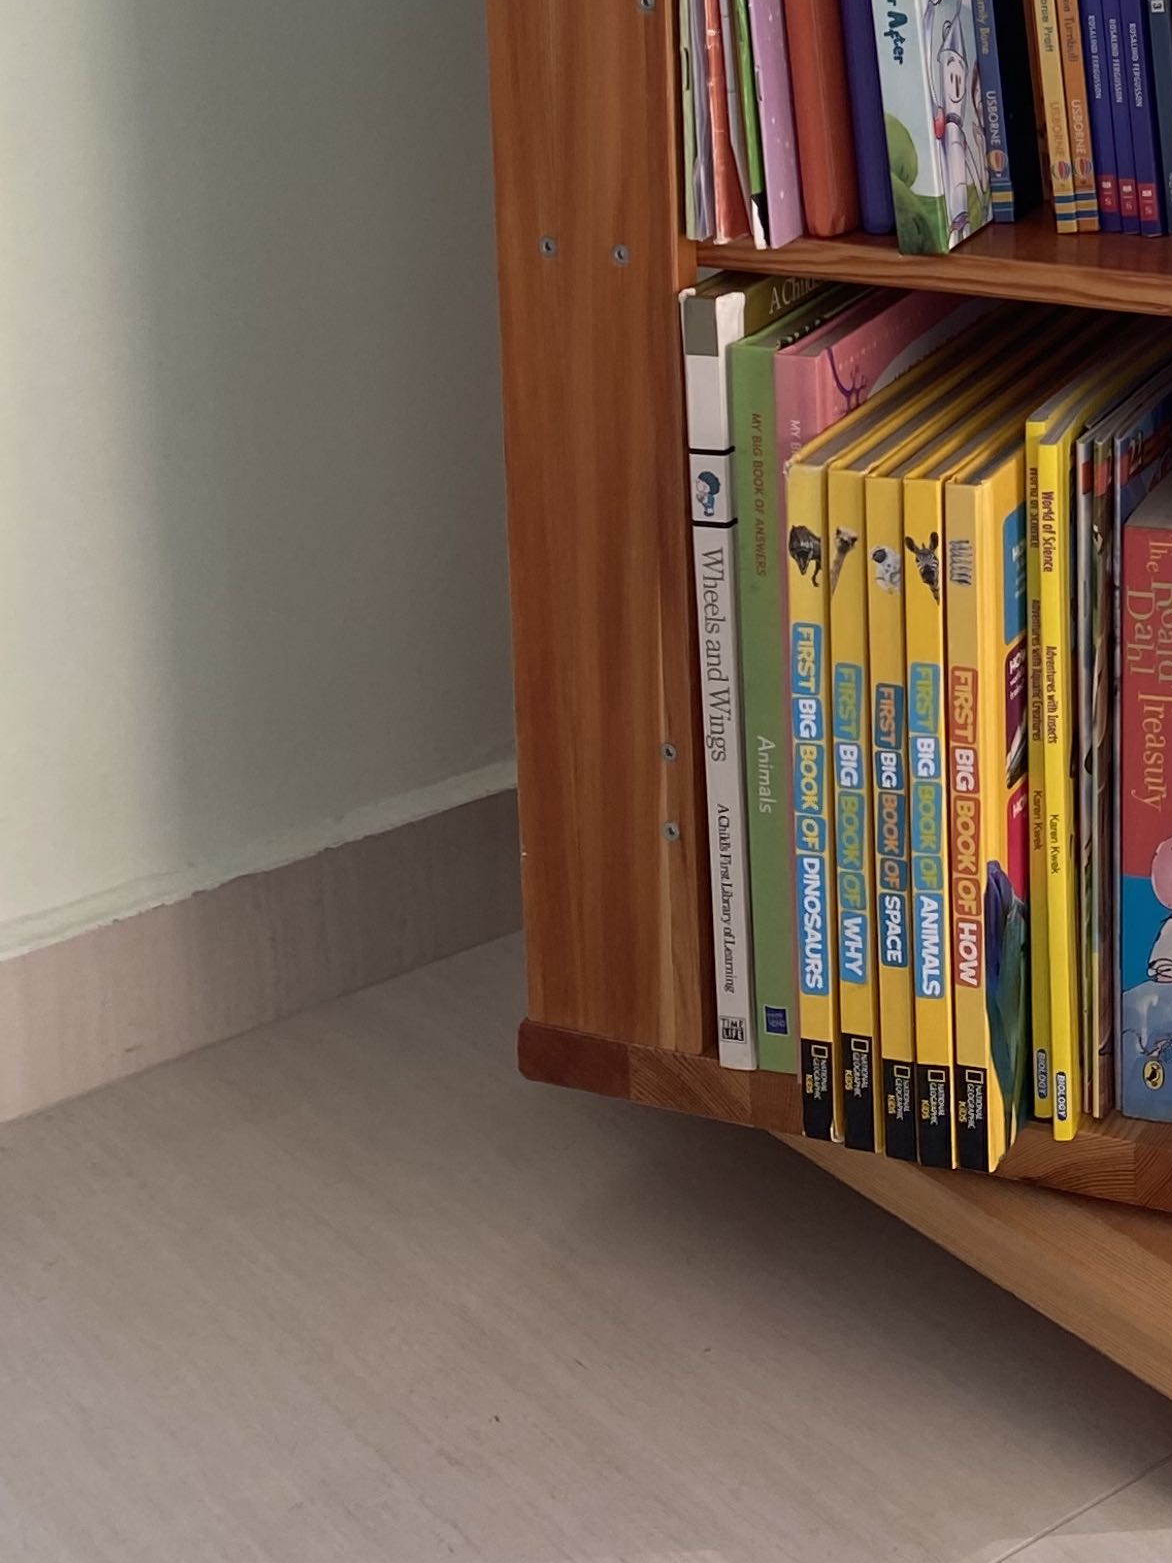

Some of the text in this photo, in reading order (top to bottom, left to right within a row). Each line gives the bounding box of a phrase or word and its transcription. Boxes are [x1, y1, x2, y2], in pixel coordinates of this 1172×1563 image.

[883, 11, 908, 65] After
[979, 28, 991, 54] Bone
[986, 91, 1001, 145] USBORNE
[1071, 99, 1086, 154] USBORNE
[753, 460, 767, 577] BOOK OF ANSWERS
[1042, 491, 1057, 572] World of Science
[702, 547, 731, 762] Wheels and Wings
[1126, 587, 1155, 673] Dahl
[1045, 646, 1059, 744] Adventures with Insects
[757, 736, 776, 814] Animals
[796, 626, 823, 988] FIRST BIG BOOK OF DINOSAURS
[838, 668, 864, 976] FIRST BIG BOOK OF WHY
[879, 687, 902, 963] FIRST BIG BOOK OF SPACE
[916, 667, 940, 996] FIRST BIG BOOK OF ANIMALS
[954, 669, 978, 985] FIRST BIG BOOK OF HOW
[1050, 814, 1061, 874] Karen Kwek
[718, 816, 738, 993] Child's First Library Learning
[1057, 1074, 1066, 1116] BIOLOGY
